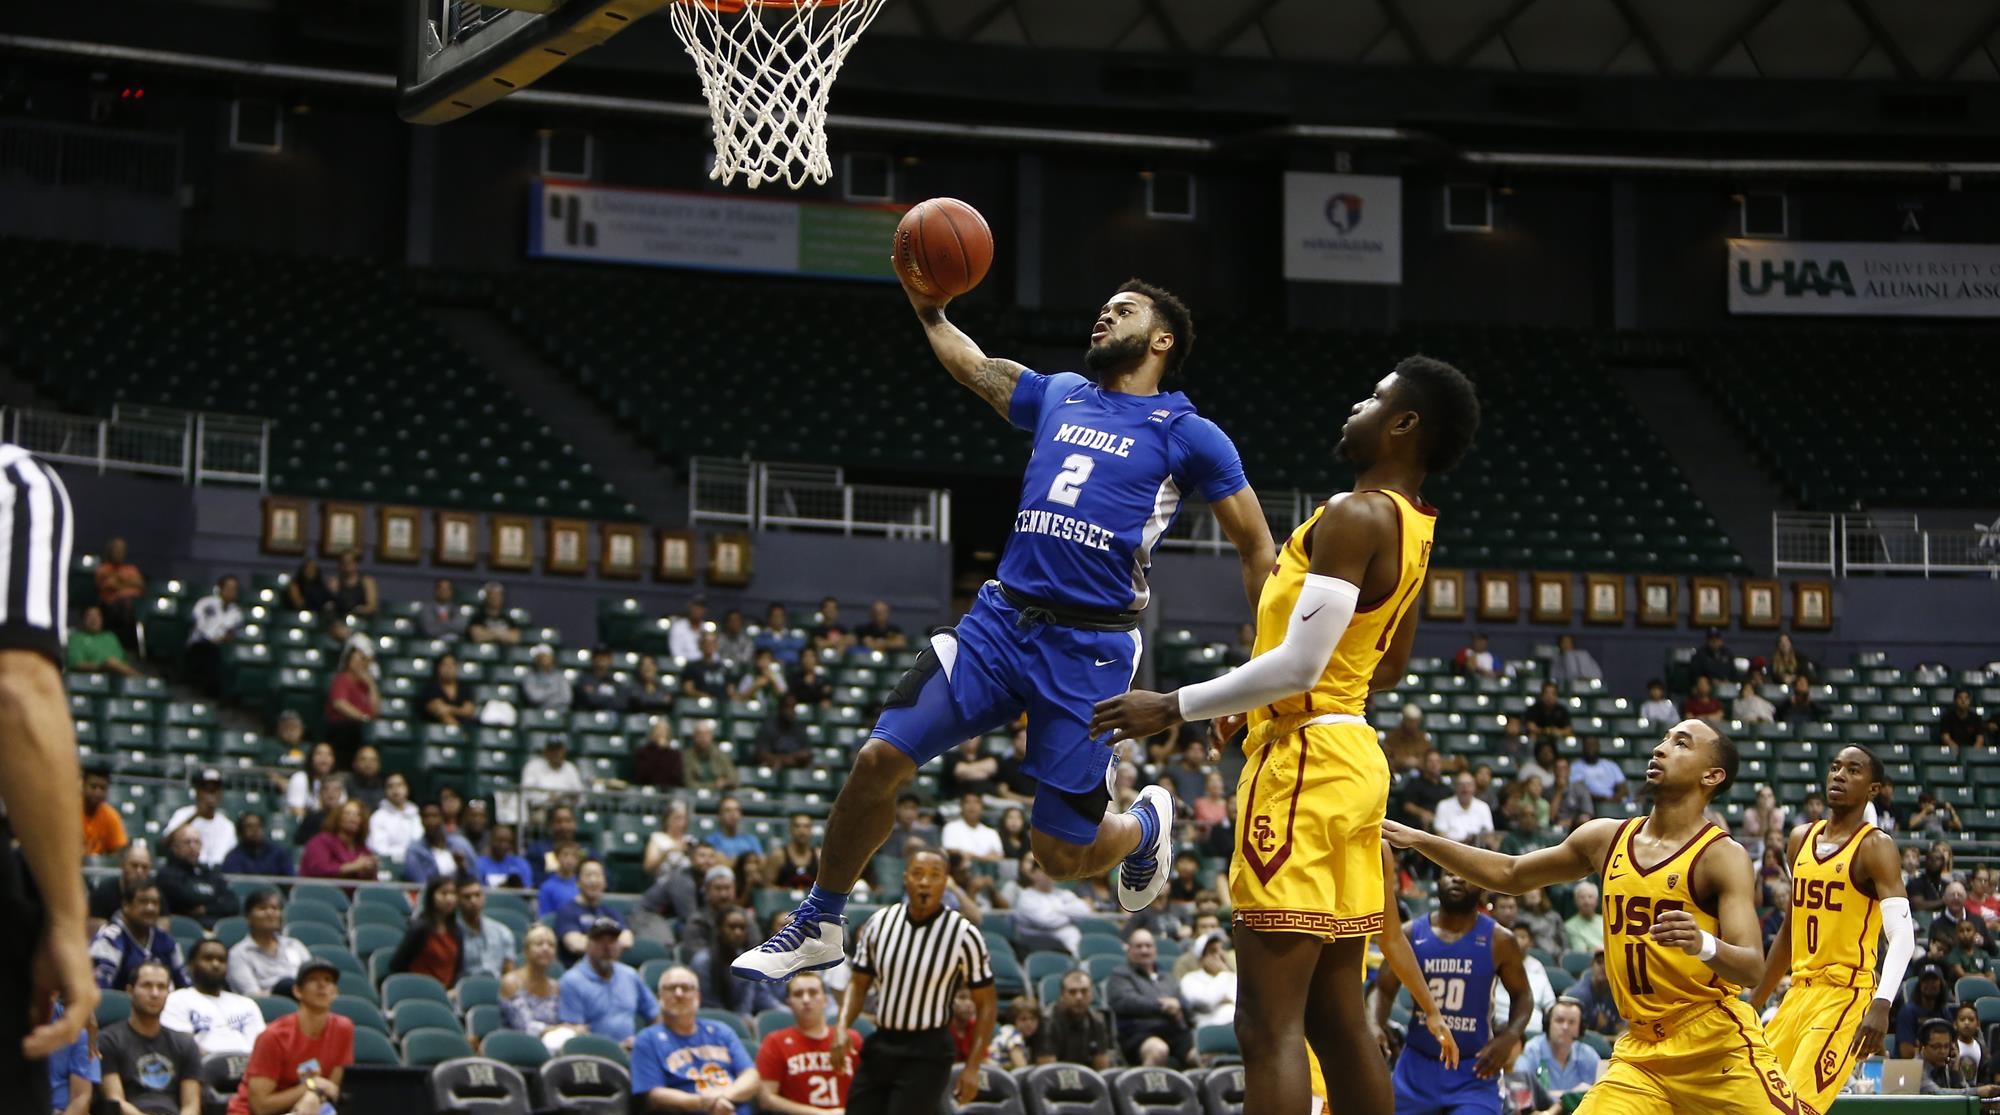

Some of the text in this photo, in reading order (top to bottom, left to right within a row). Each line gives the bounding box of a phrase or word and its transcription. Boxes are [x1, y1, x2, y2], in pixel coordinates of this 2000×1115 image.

[1739, 259, 1856, 297] UHAA
[1864, 260, 1981, 276] UNIVERSITY
[1865, 280, 1949, 299] ALUMNI
[1053, 423, 1135, 458] MIDDLE
[1046, 453, 1095, 508] 2
[1014, 509, 1114, 552] TENNESSEE
[1612, 854, 1623, 869] C
[1793, 877, 1845, 912] USC
[1807, 915, 1818, 955] 0
[1424, 958, 1473, 974] MIDDLE
[1624, 942, 1655, 995] 11
[1428, 977, 1466, 1012] 20
[787, 1051, 854, 1076] SIXES
[807, 1075, 840, 1107] 21
